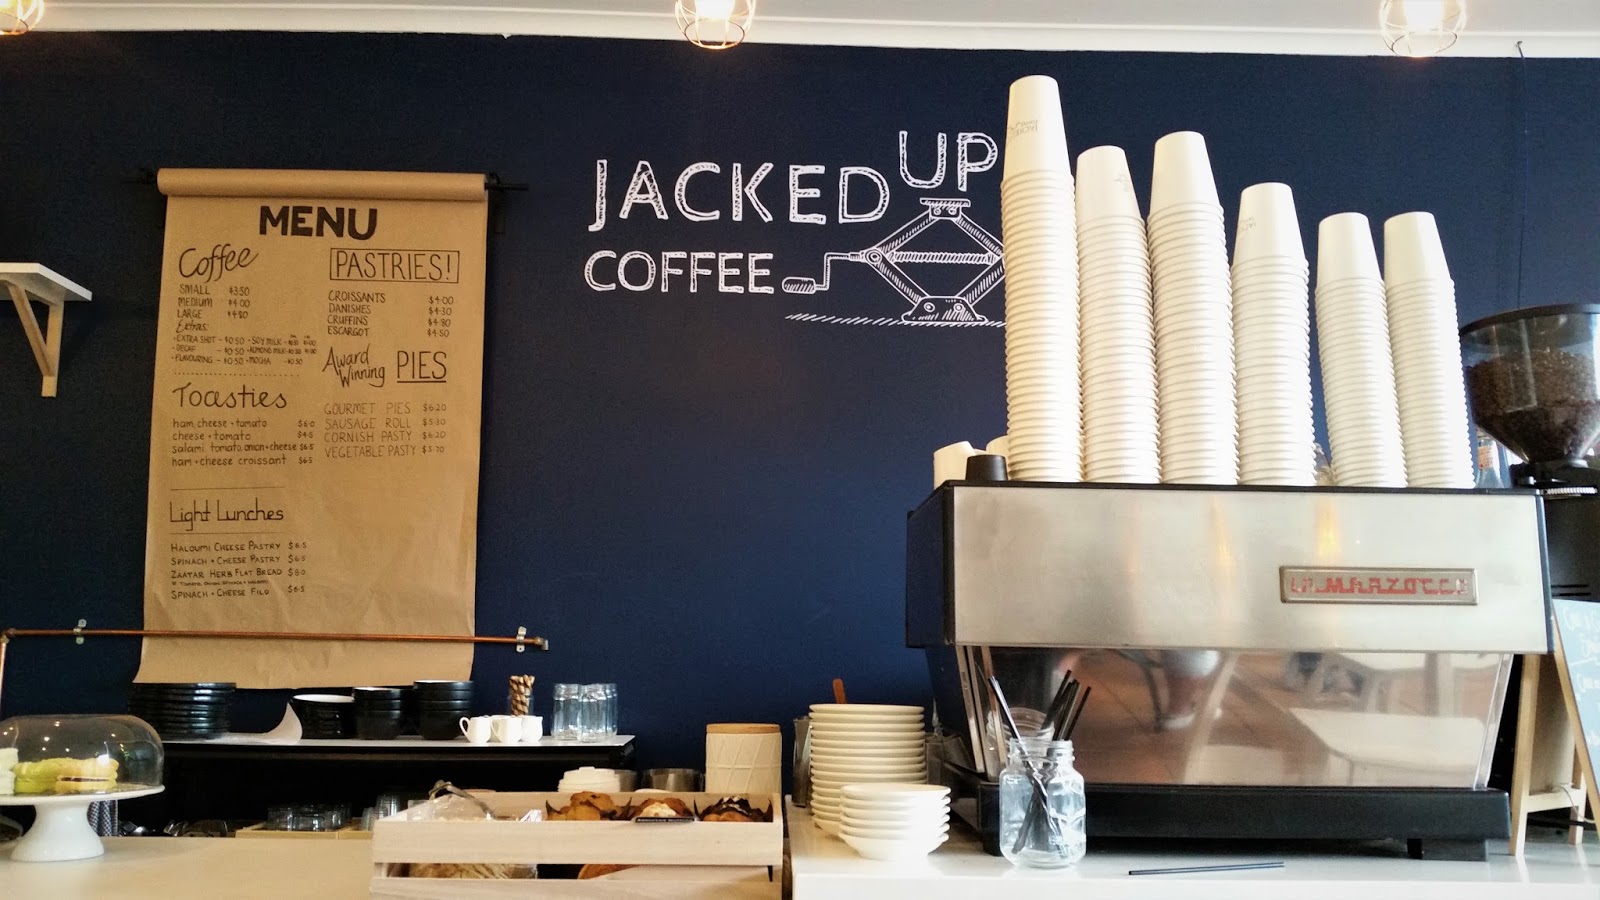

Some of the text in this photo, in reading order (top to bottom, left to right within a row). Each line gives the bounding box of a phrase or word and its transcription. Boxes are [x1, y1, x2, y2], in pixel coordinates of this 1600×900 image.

[588, 131, 998, 232] JACKED UP
[259, 205, 377, 240] MENU
[178, 244, 259, 283] Coffee
[335, 250, 452, 281] PASTRIES!
[584, 250, 775, 294] COFFEE
[180, 284, 210, 295] SMALL
[178, 297, 213, 308] MEDIUM
[328, 290, 386, 303] CROISSANTS
[177, 309, 203, 319] LARGE
[329, 303, 372, 314] DANISHES
[327, 316, 368, 326] CRUFFINS
[327, 327, 370, 337] ESCARGOT
[176, 334, 198, 343] EXTRA
[200, 336, 216, 344] SHOT
[176, 344, 197, 352] DECAF
[175, 354, 213, 363] FLAVOURING
[322, 343, 371, 376] Award
[397, 351, 447, 380] PIES
[338, 366, 386, 388] Winning
[172, 382, 287, 409] Toasties
[324, 403, 376, 415] GOURMET
[387, 402, 412, 414] PIES
[197, 418, 227, 428] cheese
[236, 418, 268, 428] tomato
[324, 418, 376, 430] SAUSAGE
[385, 418, 412, 429] ROLL
[172, 430, 205, 441] cheese
[214, 430, 251, 441] tomato
[324, 432, 374, 443] CORNISH
[381, 431, 413, 442] PASTY
[270, 441, 297, 451] cheese
[324, 446, 383, 459] VEGETABLE
[387, 445, 417, 456] PASTY
[172, 456, 192, 467] ham
[200, 456, 233, 466] cheese
[238, 454, 287, 465] croissant
[169, 497, 284, 532] Light Lunches
[171, 543, 211, 552] HALOUMI
[214, 542, 245, 551] CHEESE
[248, 541, 281, 550] PASTRY
[171, 557, 207, 566] SPINACH
[217, 557, 247, 565] CHEESE
[250, 554, 281, 563] PASTRY
[171, 571, 204, 579] ZAATAR
[210, 569, 233, 578] HERB
[235, 569, 253, 577] FLAT
[256, 568, 282, 576] BREAD
[171, 590, 208, 600] SPINACH
[217, 589, 246, 597] CHEESE
[251, 588, 270, 596] FILO
